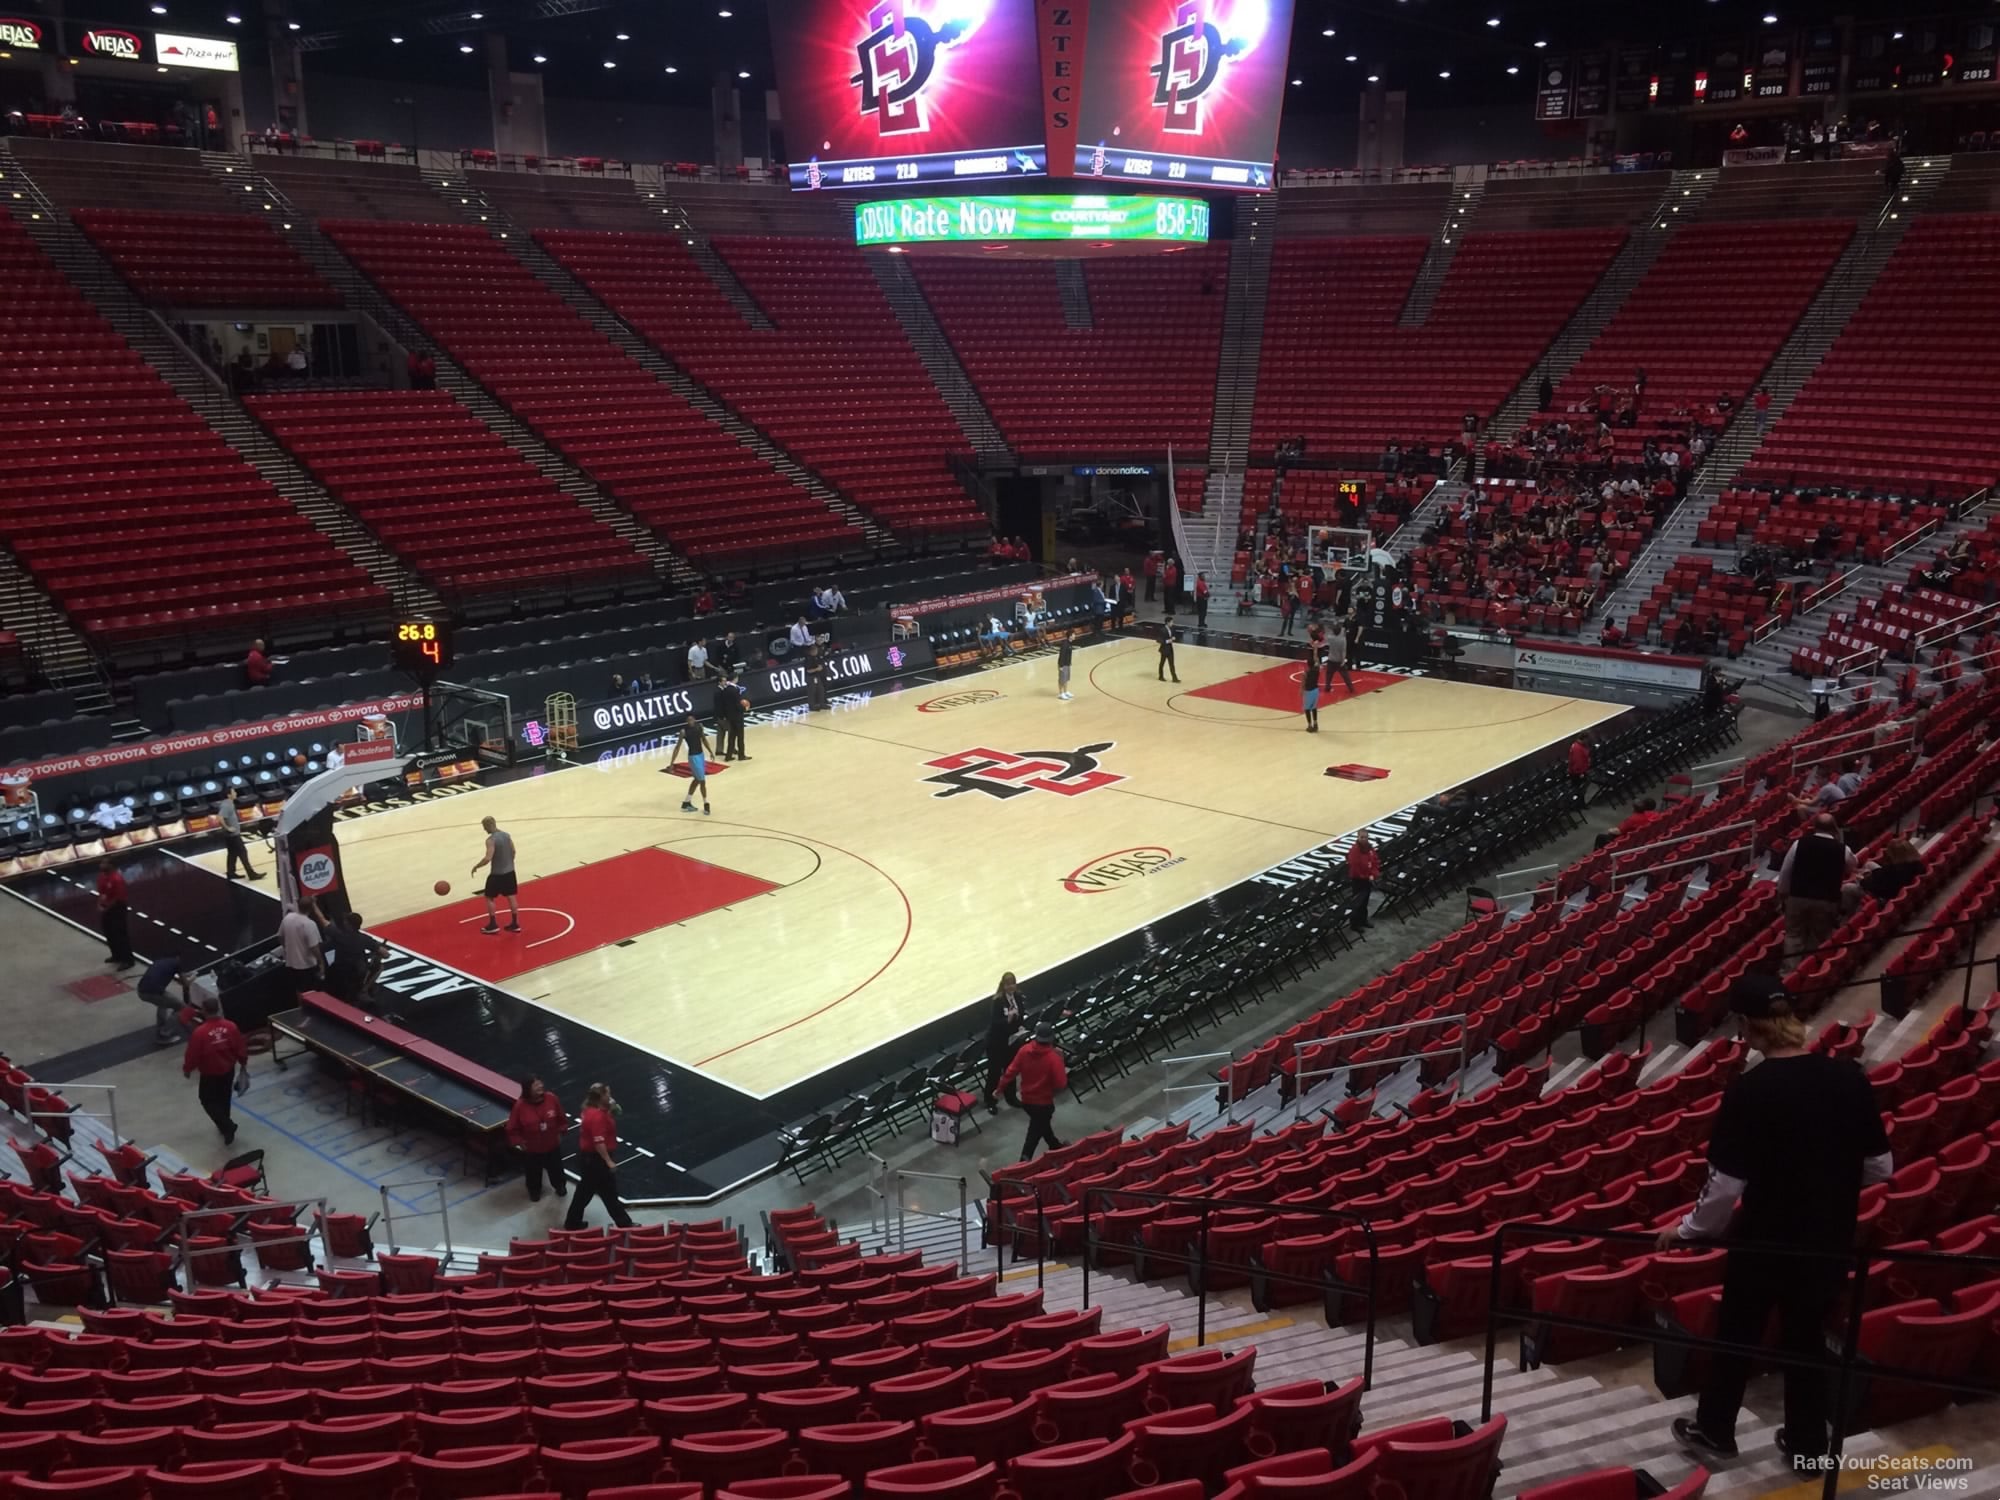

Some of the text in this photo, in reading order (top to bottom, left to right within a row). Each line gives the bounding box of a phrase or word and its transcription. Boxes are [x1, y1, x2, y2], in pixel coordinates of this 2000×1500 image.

[0, 24, 35, 45] IEJAS
[88, 31, 135, 55] VIEJAS
[185, 46, 233, 60] Pizza Hut
[1048, 0, 1074, 129] ZTECS
[1962, 69, 1991, 81] 2013
[1760, 85, 1783, 96] 2010
[863, 206, 895, 240] SDSU
[901, 203, 950, 237] Rate
[959, 201, 1018, 236] Now
[1350, 494, 1359, 507] 4
[399, 624, 435, 641] 26.8
[423, 641, 440, 664] 4
[769, 653, 873, 694] GOAZS.COM
[396, 696, 425, 708] TOOT
[915, 691, 996, 710] VIEJAS
[343, 704, 380, 719] TOYOTA
[593, 690, 694, 731] @GOAZTECS
[287, 714, 327, 729] TOYOTA
[230, 725, 271, 739] TOYOTA
[166, 735, 210, 751] TOYOTA
[102, 747, 148, 763] TOYOTA
[34, 758, 82, 776] TOYOTA
[303, 858, 329, 876] BAY
[303, 869, 330, 882] ALARM
[1056, 850, 1188, 888] VIEJAS arena
